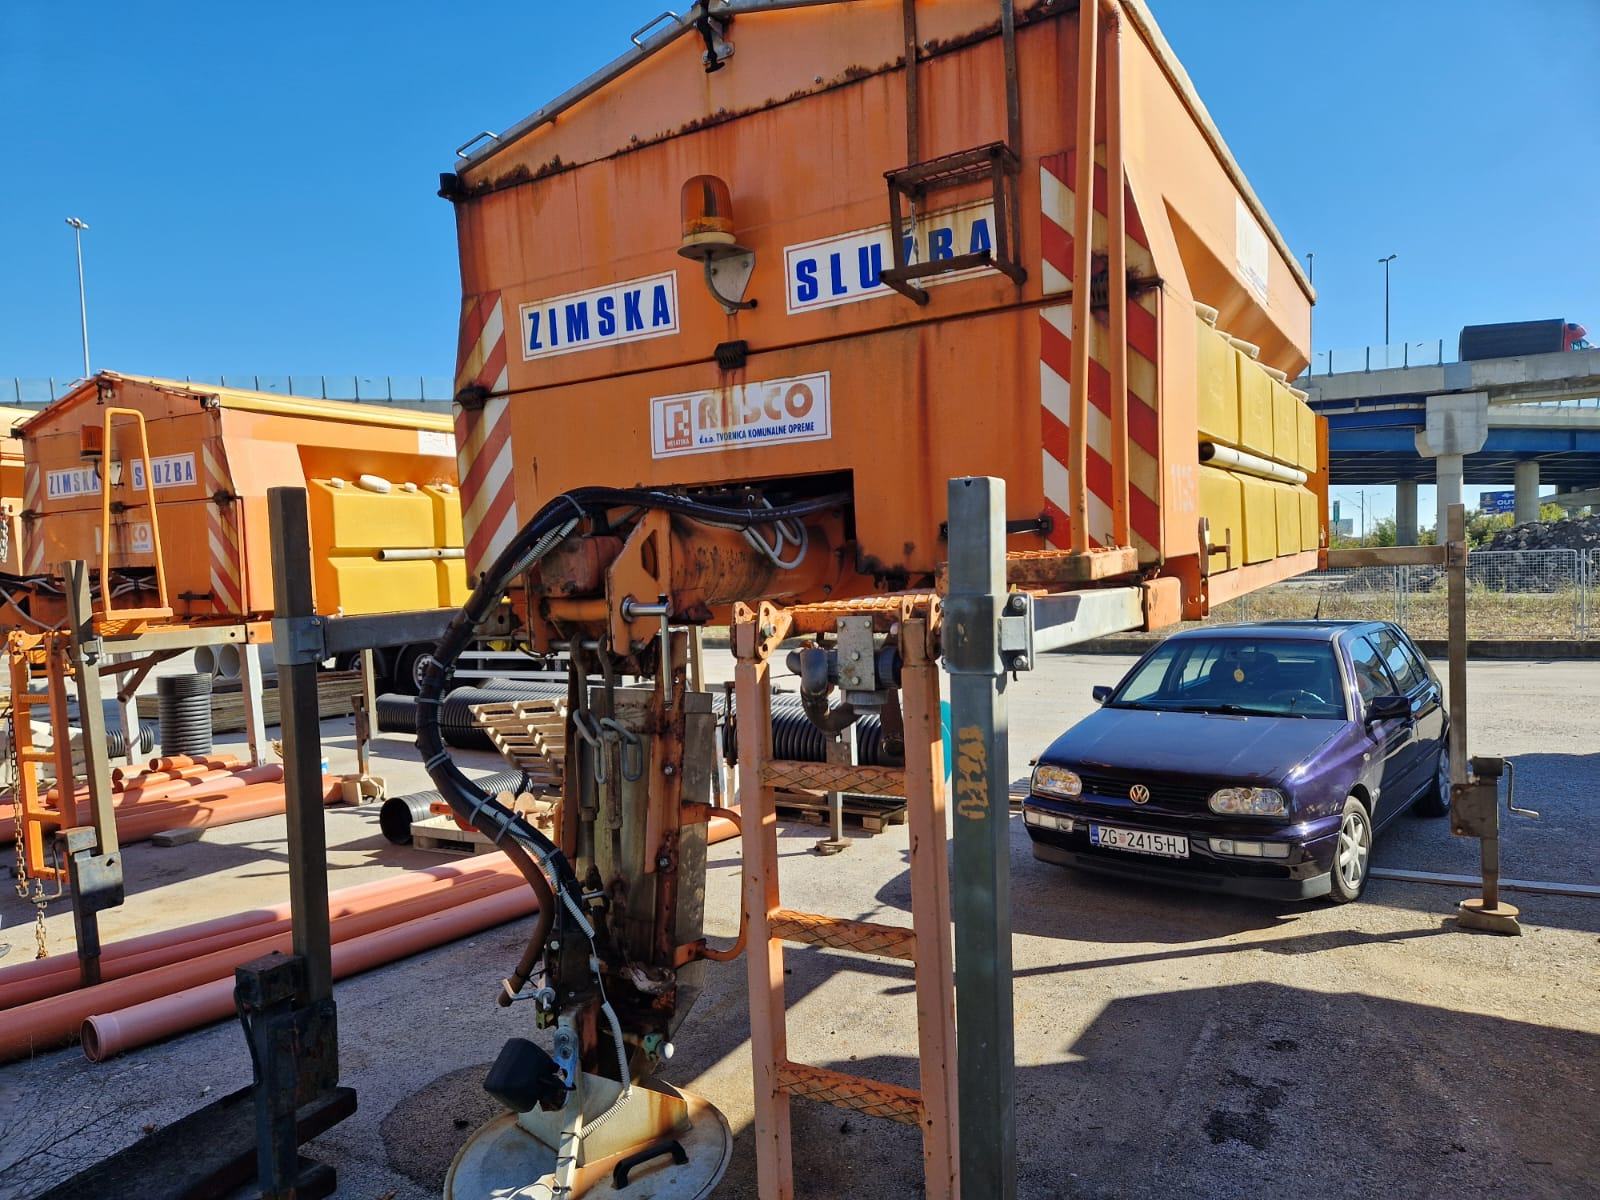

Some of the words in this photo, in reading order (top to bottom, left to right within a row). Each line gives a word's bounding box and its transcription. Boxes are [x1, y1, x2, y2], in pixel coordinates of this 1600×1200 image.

[528, 284, 671, 350] ZIMSKA
[716, 430, 747, 442] TVORNICA
[748, 424, 787, 438] KOMUNALNE
[788, 421, 815, 434] OPREME
[49, 470, 98, 495] ZIMSKA
[135, 460, 193, 486] SUŽBA
[1100, 828, 1117, 844] ZG
